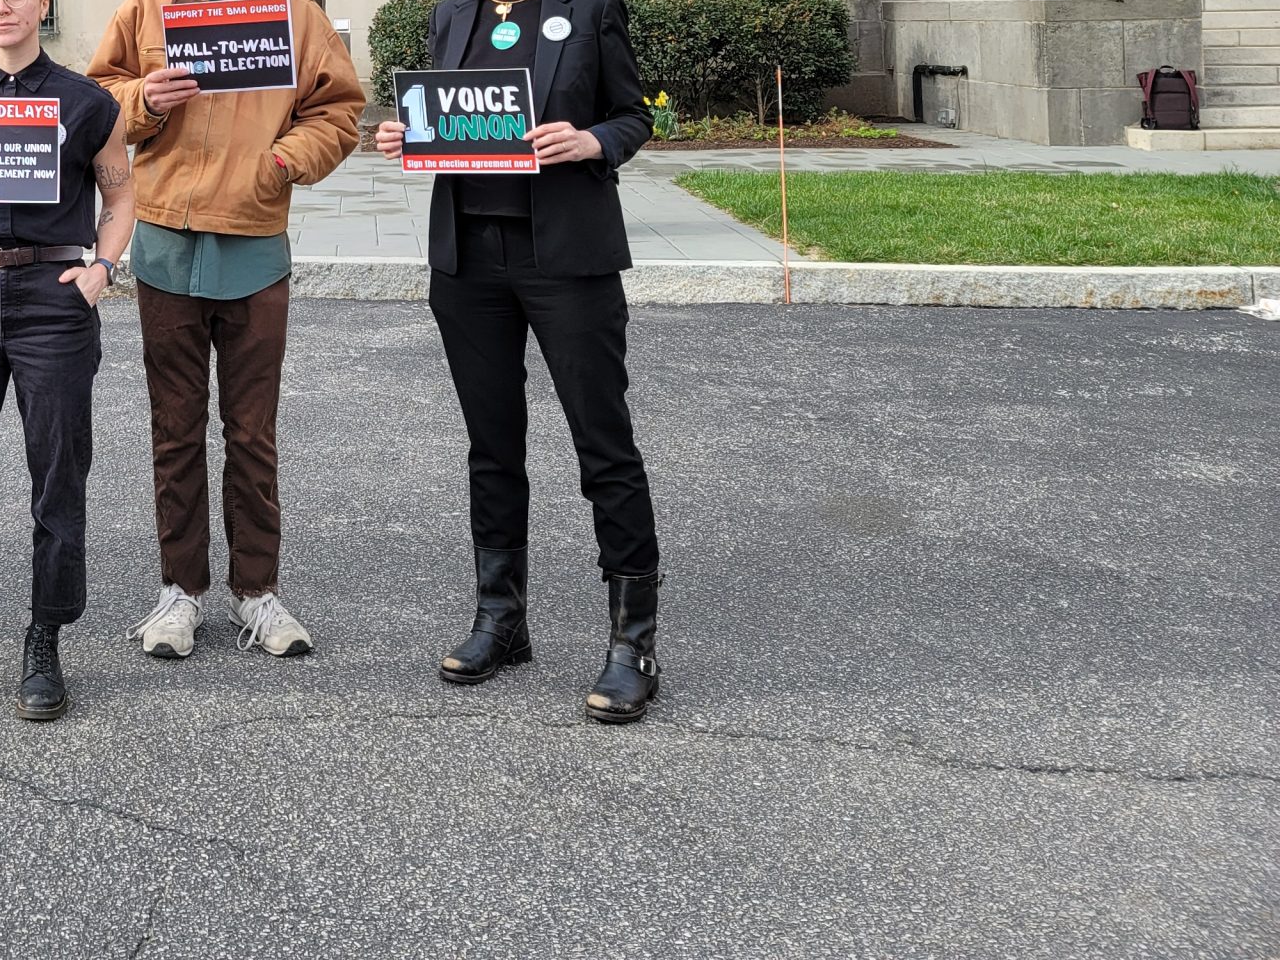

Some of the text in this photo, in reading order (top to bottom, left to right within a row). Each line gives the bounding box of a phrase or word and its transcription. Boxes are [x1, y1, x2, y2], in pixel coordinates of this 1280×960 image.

[164, 4, 286, 20] SUPPORT THE BMA GUARDS
[167, 37, 289, 58] WALL-TO-WALL
[220, 54, 290, 72] ELECTION
[438, 86, 520, 113] VOICE
[402, 84, 435, 143] 1
[439, 114, 526, 140] UNION
[4, 143, 21, 152] OUR
[24, 144, 51, 153] UNION
[407, 160, 533, 168] Sign the election agreement now!
[34, 170, 55, 179] NOW
